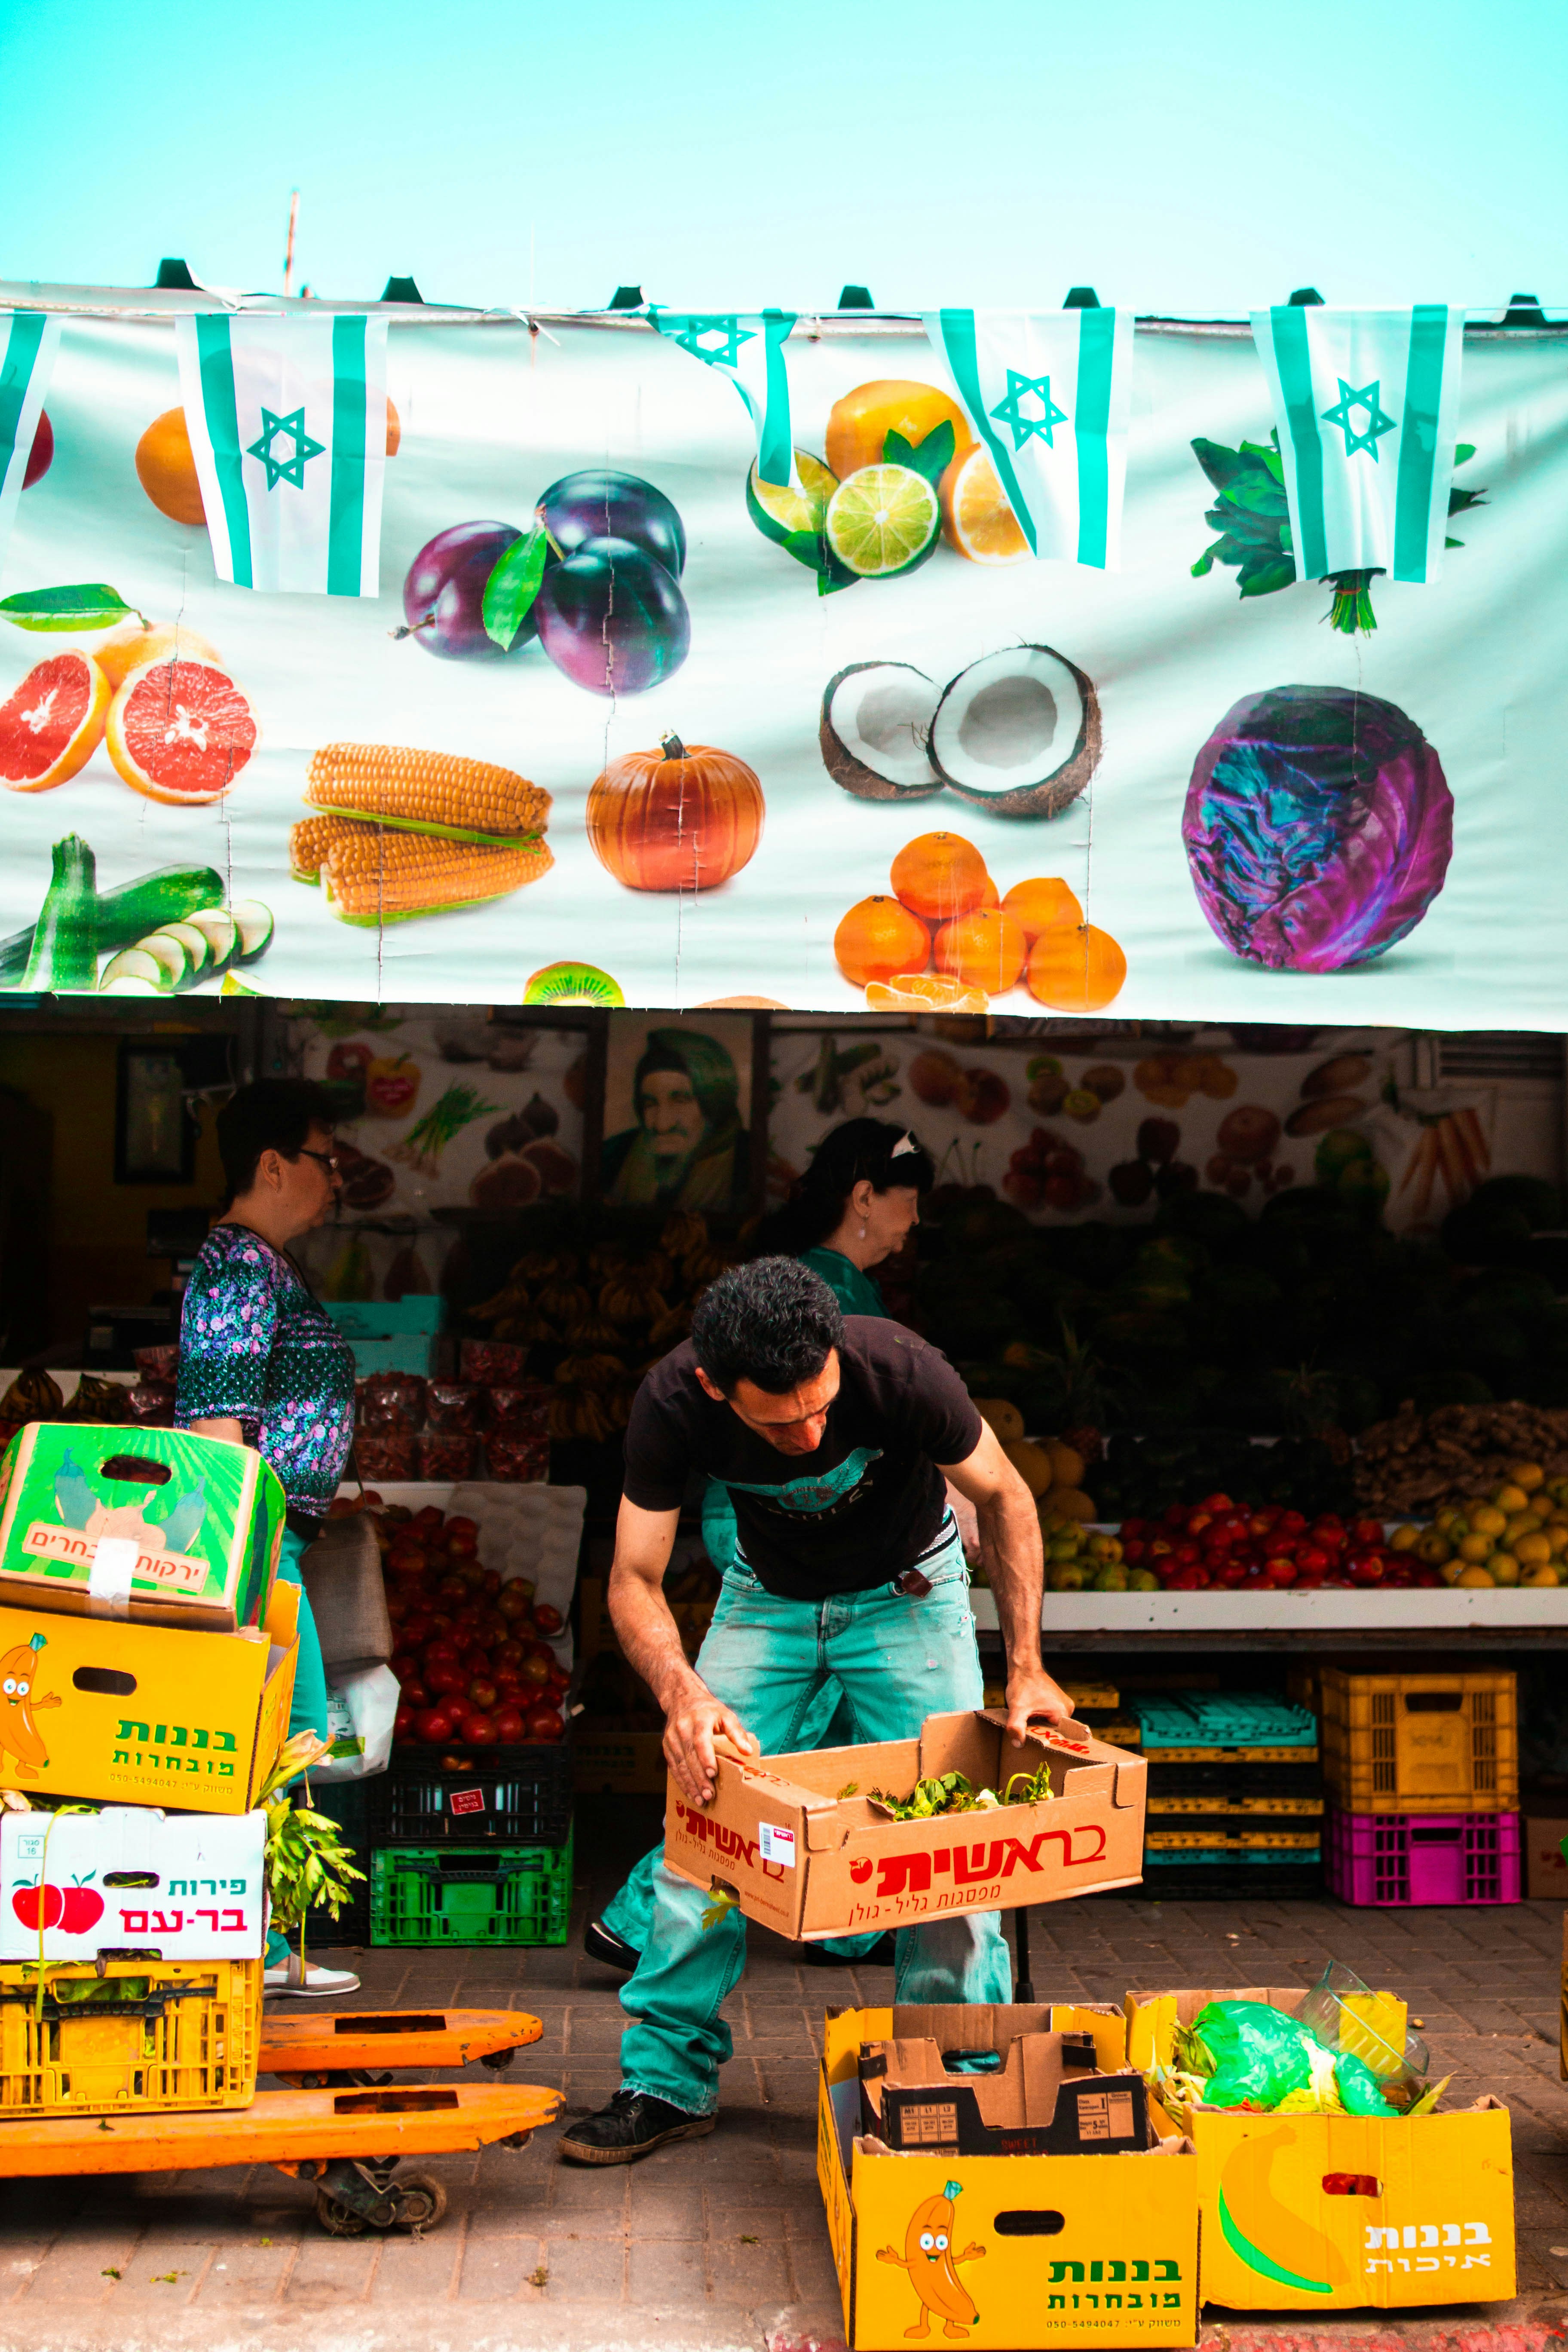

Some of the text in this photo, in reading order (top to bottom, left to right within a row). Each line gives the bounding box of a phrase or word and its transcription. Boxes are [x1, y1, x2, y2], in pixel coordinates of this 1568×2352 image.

[135, 1556, 199, 1580] ירקות
[115, 1719, 238, 1753] בננות
[112, 1749, 235, 1776] מובחרות
[110, 1774, 177, 1788] 050-5494047
[203, 1785, 233, 1794] משווק
[708, 1849, 735, 1871] מפסגות
[876, 1824, 1106, 1898] בראשית
[168, 1879, 247, 1896] פירות
[936, 1884, 1001, 1908] מפסגות
[118, 1908, 248, 1933] בר-עם
[1364, 2222, 1492, 2249] בננות
[1047, 2259, 1182, 2283] בננות
[1365, 2254, 1491, 2273] איכות
[1047, 2293, 1182, 2310] מובחרות
[1046, 2320, 1120, 2329] 050-5494047
[1148, 2319, 1181, 2329] משווק
